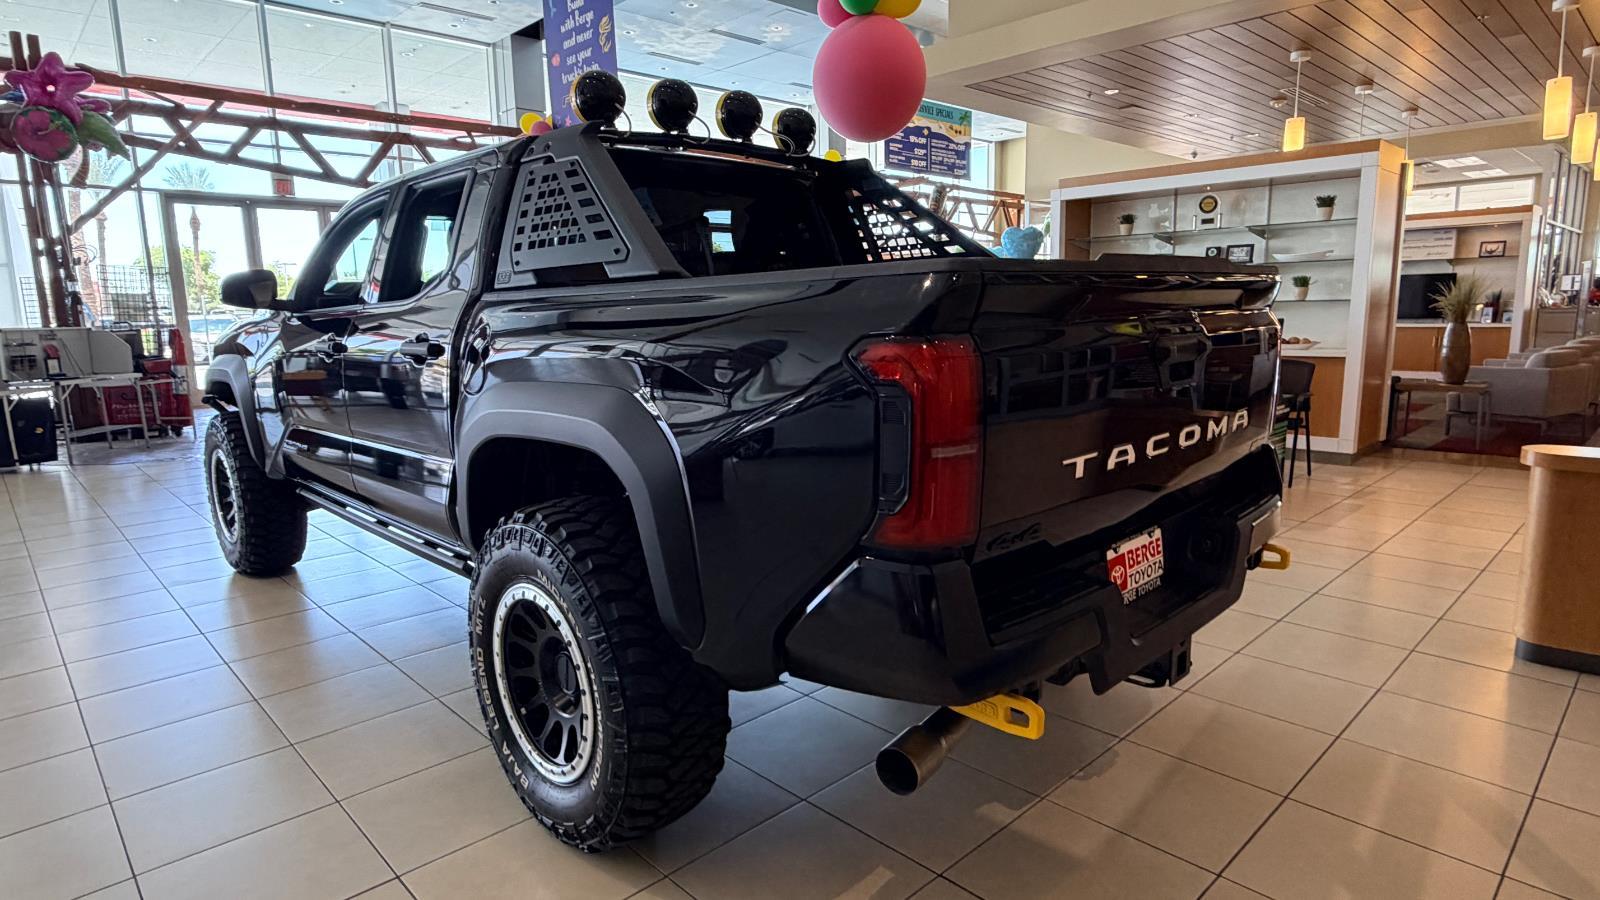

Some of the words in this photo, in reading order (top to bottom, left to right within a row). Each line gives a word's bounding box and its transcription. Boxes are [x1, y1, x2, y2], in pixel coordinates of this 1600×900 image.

[560, 15, 575, 33] with
[575, 10, 594, 28] Berge
[563, 32, 576, 49] and
[576, 29, 593, 43] never
[566, 54, 576, 65] see
[577, 47, 592, 66] your
[1062, 407, 1249, 480] TACOMA
[1126, 537, 1162, 570] BERGE
[1129, 559, 1164, 588] TOYOTA
[537, 568, 583, 639] MICKEY
[1122, 588, 1137, 605] RGE
[1138, 577, 1162, 597] TOYOTA
[476, 595, 486, 636] MTZ
[476, 647, 500, 731] LEGEND
[502, 740, 529, 790] BAJA
